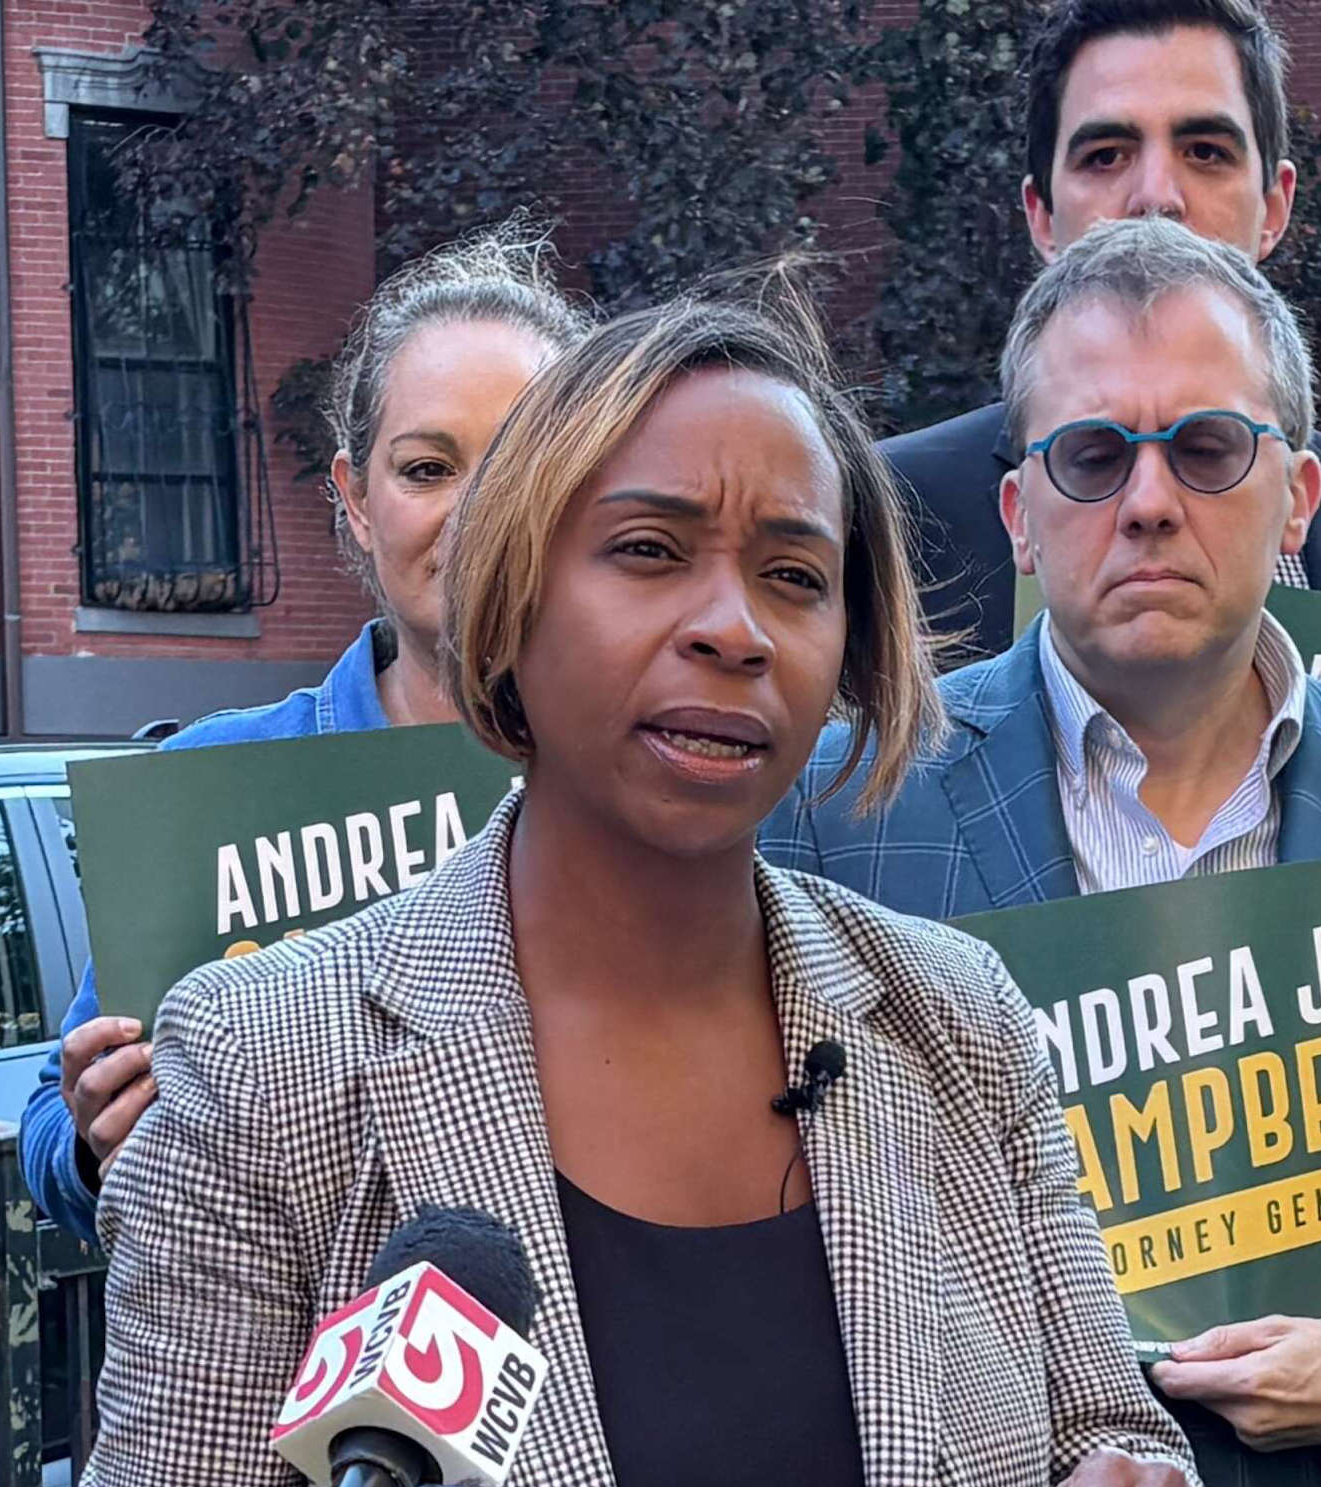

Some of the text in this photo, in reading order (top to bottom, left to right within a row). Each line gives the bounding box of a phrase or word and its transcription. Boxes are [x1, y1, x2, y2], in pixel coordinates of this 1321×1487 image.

[1034, 946, 1273, 1093] NDREA
[1112, 1211, 1235, 1275] ORNEY
[349, 1280, 411, 1389] WCVB
[377, 1267, 500, 1435] 5
[471, 1352, 536, 1466] WCVB
